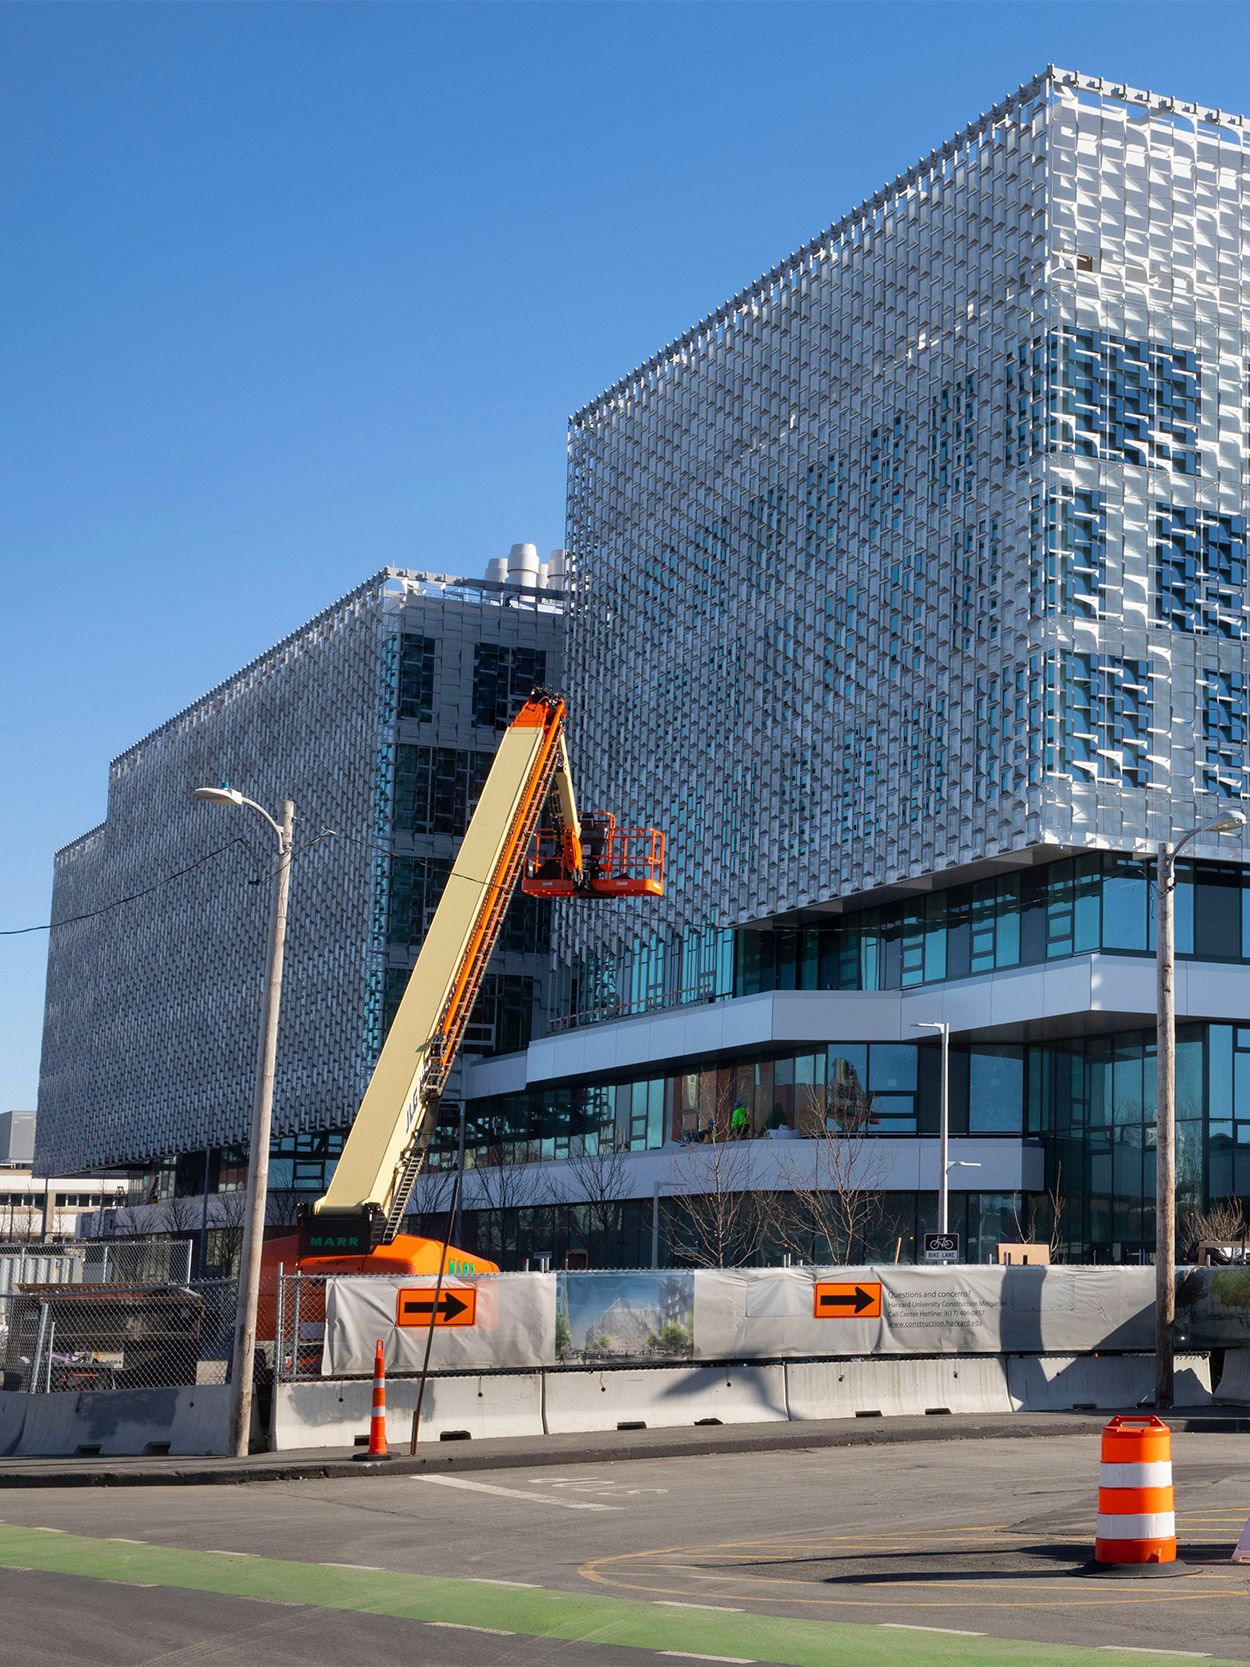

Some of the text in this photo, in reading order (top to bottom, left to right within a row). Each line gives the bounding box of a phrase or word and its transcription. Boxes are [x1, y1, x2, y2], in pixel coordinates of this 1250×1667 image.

[405, 1086, 418, 1136] JLG
[310, 1237, 359, 1247] MARR
[887, 1290, 971, 1299] Questions and concerns?
[912, 1301, 941, 1309] University
[942, 1300, 978, 1308] Construction
[887, 1310, 899, 1318] Call
[899, 1310, 919, 1318] Center
